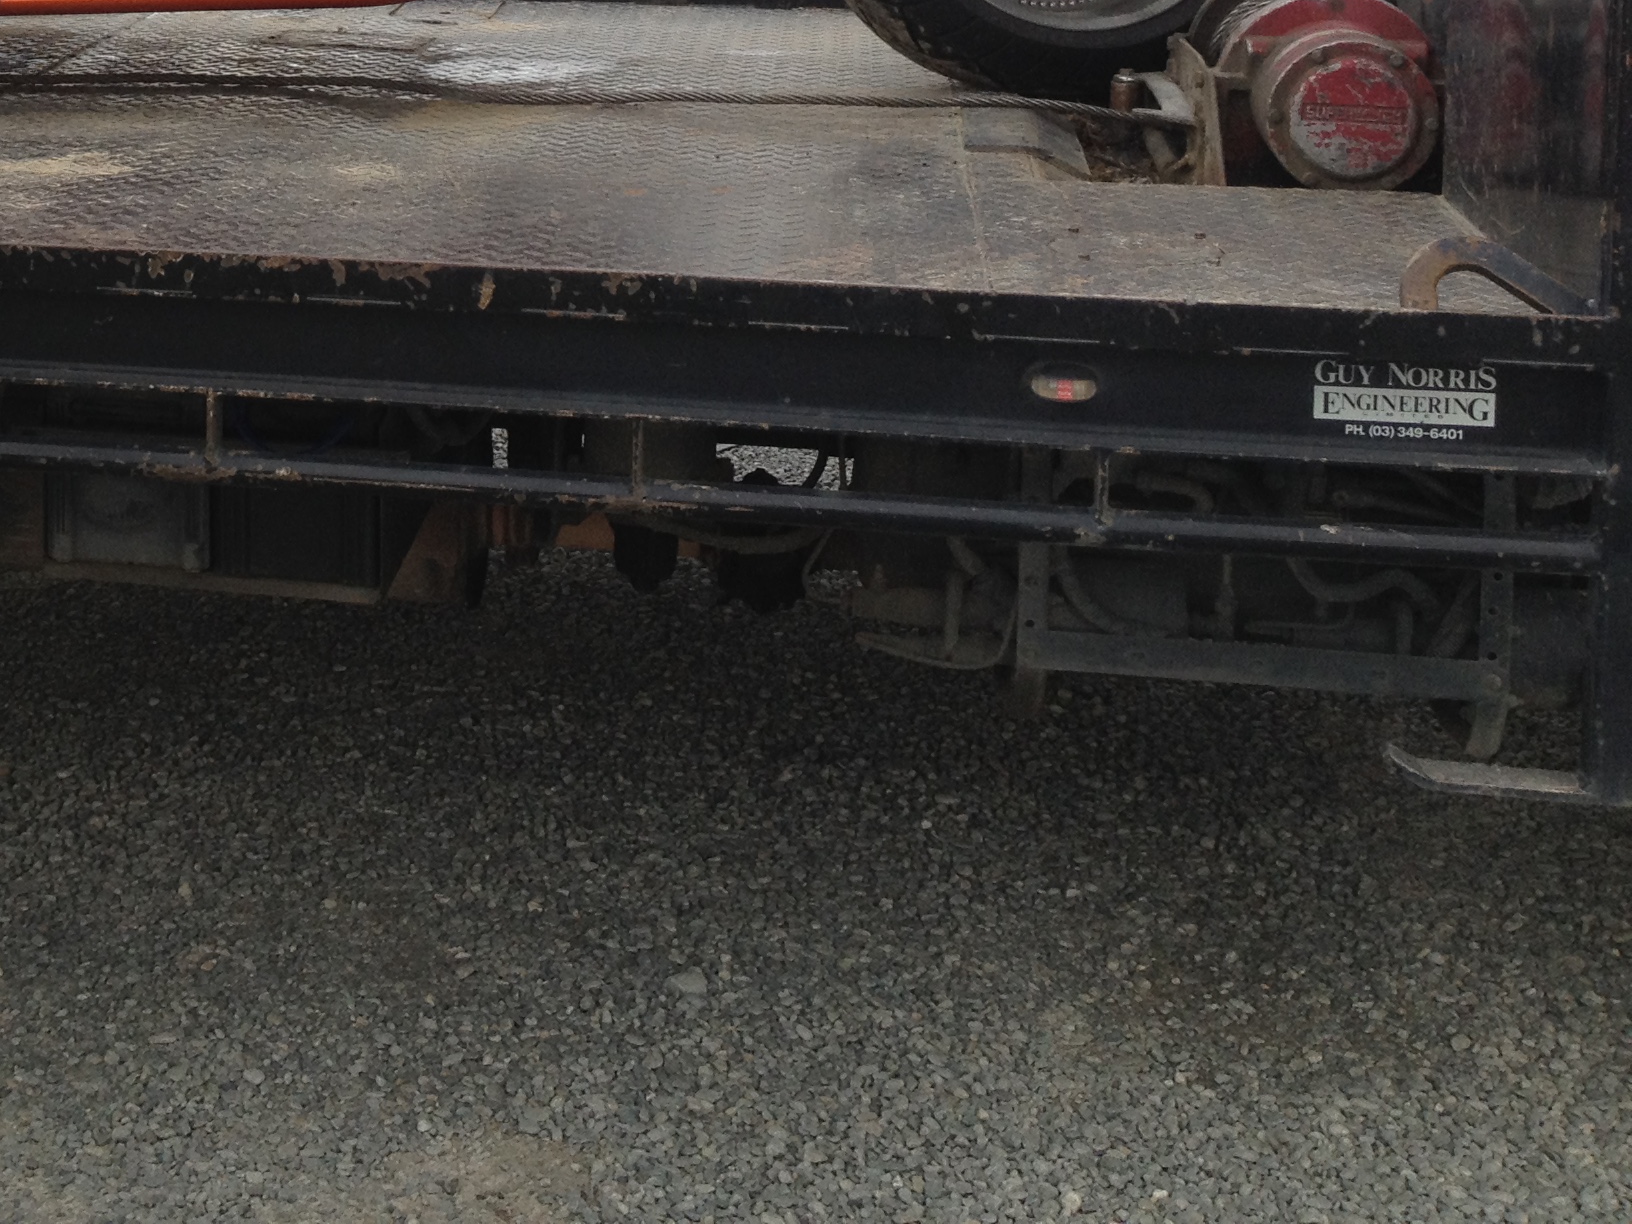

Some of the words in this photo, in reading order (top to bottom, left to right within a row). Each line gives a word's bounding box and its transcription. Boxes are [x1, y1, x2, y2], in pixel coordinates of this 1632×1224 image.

[1314, 359, 1375, 386] GUY
[1388, 362, 1498, 391] NORRIS
[1321, 391, 1491, 422] ENGINEERING
[1368, 424, 1395, 440] (03)
[1396, 426, 1464, 441] 349-6401
